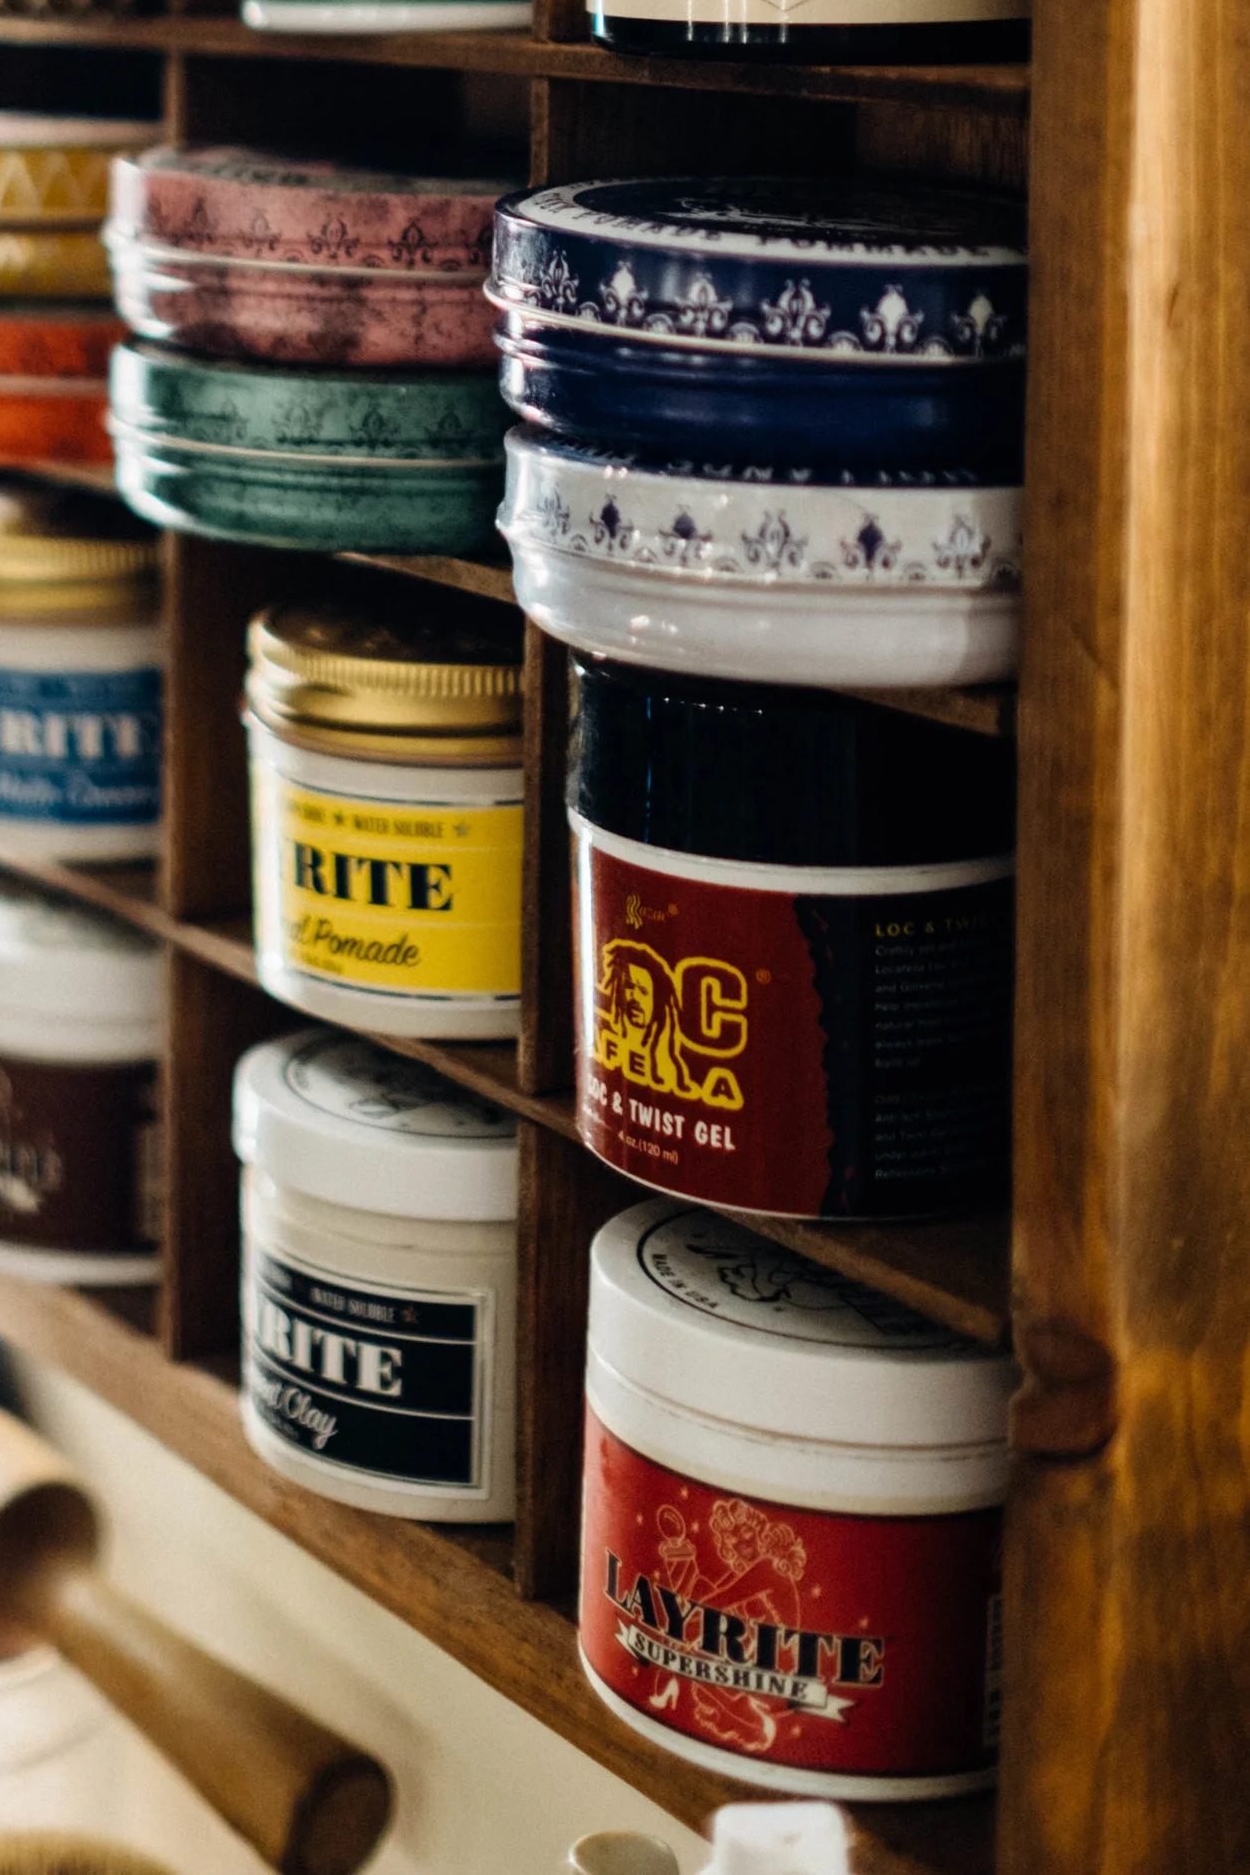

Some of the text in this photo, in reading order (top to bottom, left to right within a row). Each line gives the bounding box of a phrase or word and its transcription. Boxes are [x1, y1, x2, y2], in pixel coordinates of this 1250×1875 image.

[312, 917, 422, 967] Pomade
[874, 921, 916, 938] LOC
[612, 1091, 624, 1116] &
[629, 1098, 685, 1139] TWIST
[695, 1120, 736, 1151] GEL
[652, 1253, 675, 1278] MADE
[604, 1547, 884, 1689] LAYRITE
[634, 1631, 810, 1702] SUPERSHINE
